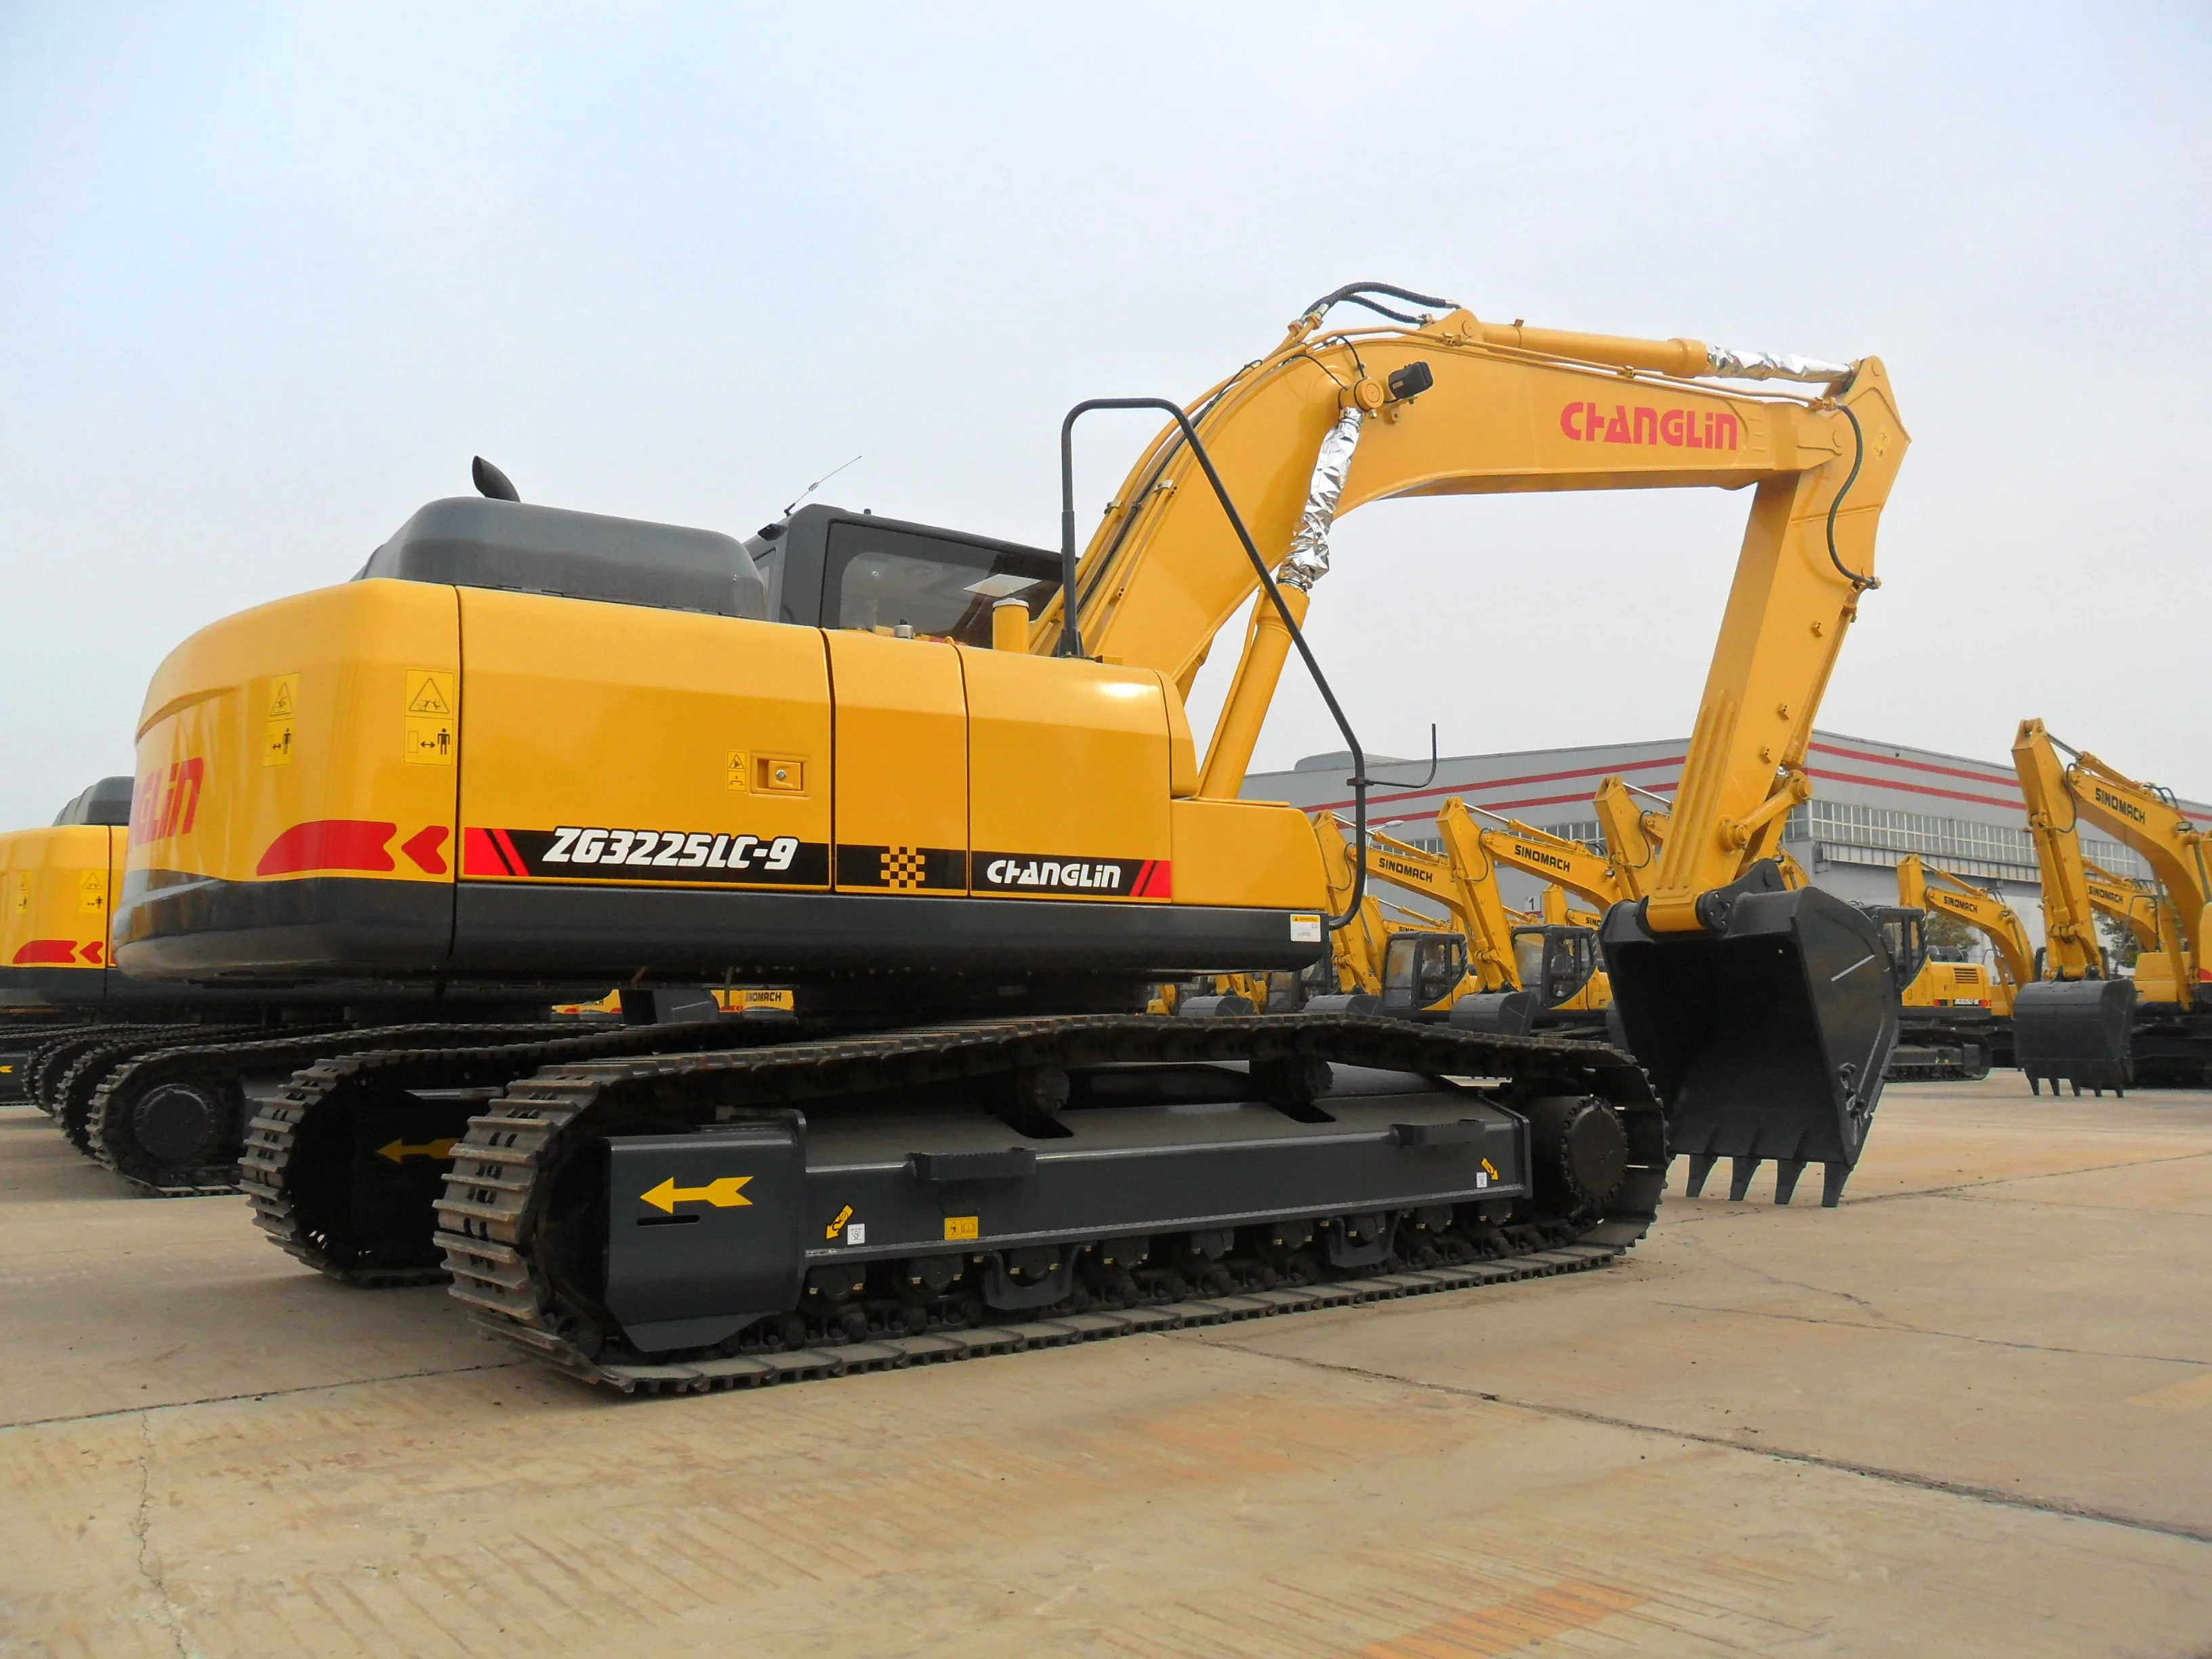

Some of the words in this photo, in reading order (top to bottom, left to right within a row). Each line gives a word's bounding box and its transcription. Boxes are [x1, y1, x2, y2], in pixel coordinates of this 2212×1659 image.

[2095, 787, 2146, 825] SINOMACH
[542, 827, 798, 870] ZG3225LC-9
[1515, 844, 1570, 872] SINOMACH
[1379, 857, 1433, 883] SINOMACH
[1528, 897, 1534, 911] 1
[1944, 895, 1978, 914] SINOMACH
[2089, 885, 2124, 904] SINOMACH
